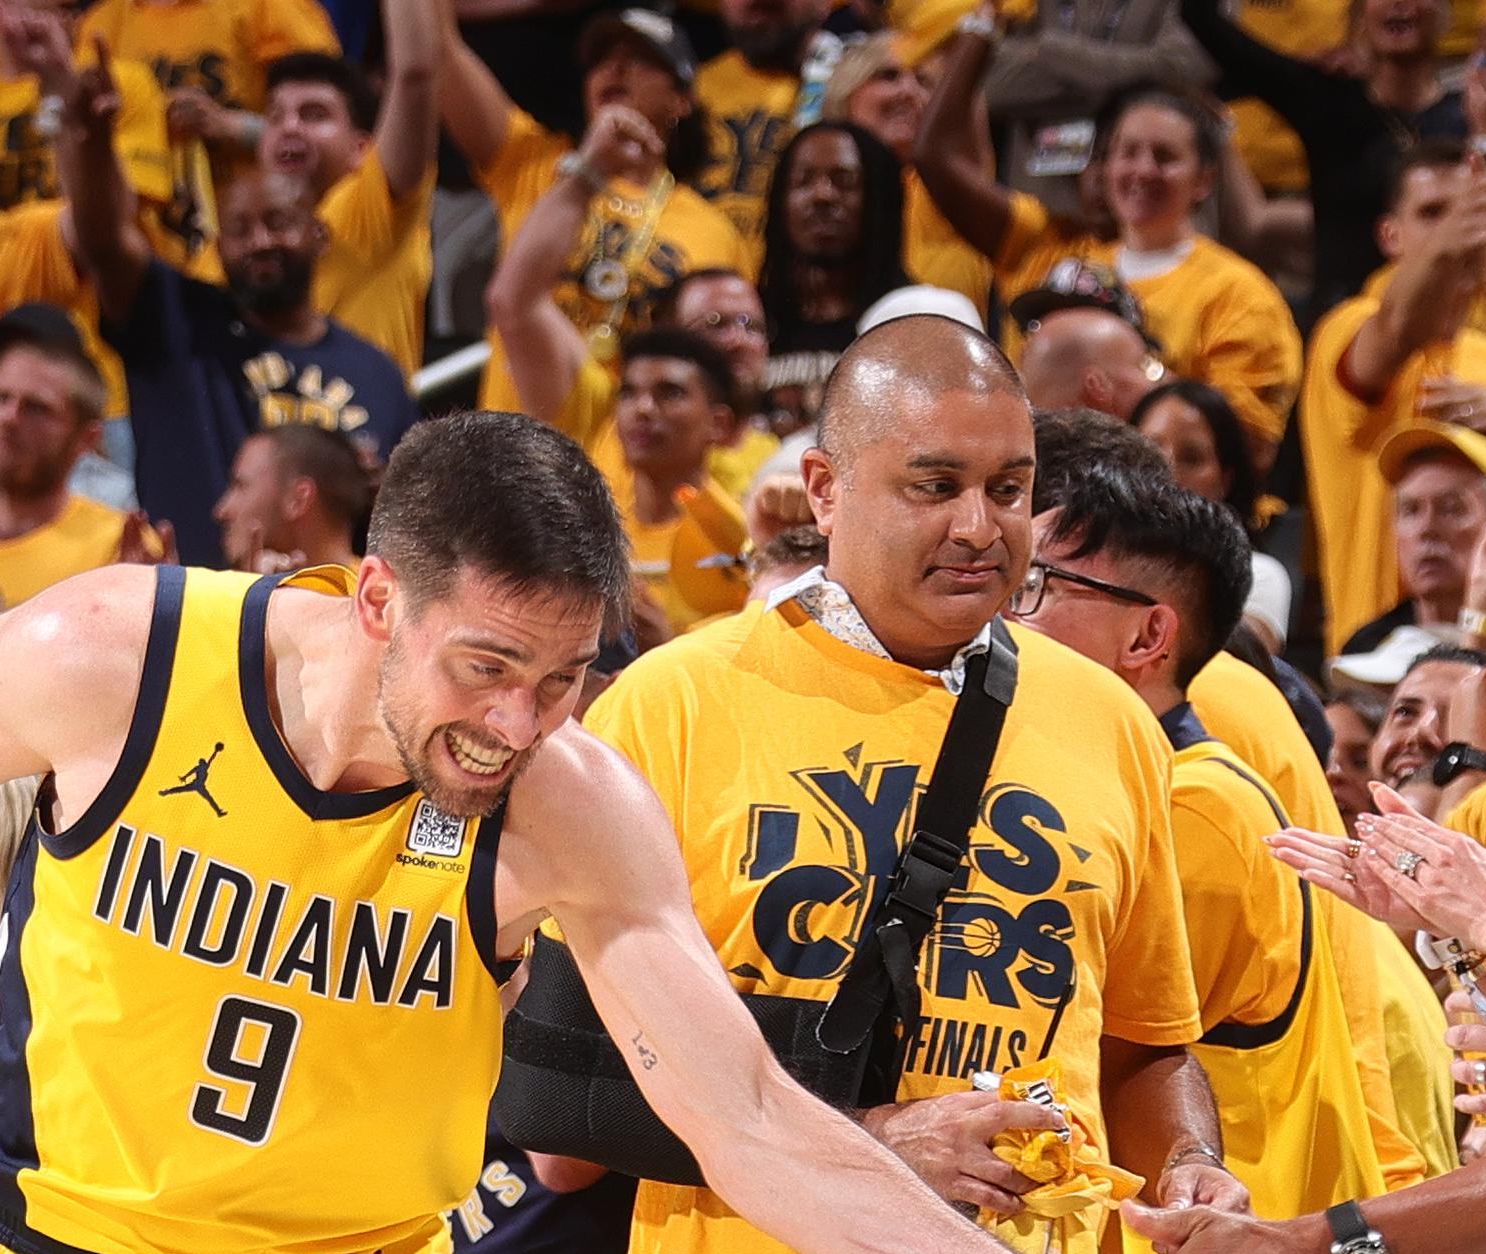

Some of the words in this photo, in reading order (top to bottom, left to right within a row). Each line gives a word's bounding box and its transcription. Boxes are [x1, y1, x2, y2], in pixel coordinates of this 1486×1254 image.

[396, 853, 465, 874] spokenote
[790, 759, 1067, 895] YS
[95, 821, 458, 1010] INDIANA
[753, 864, 1075, 1009] CRS
[188, 994, 304, 1147] 9
[905, 1015, 1026, 1079] FINALS
